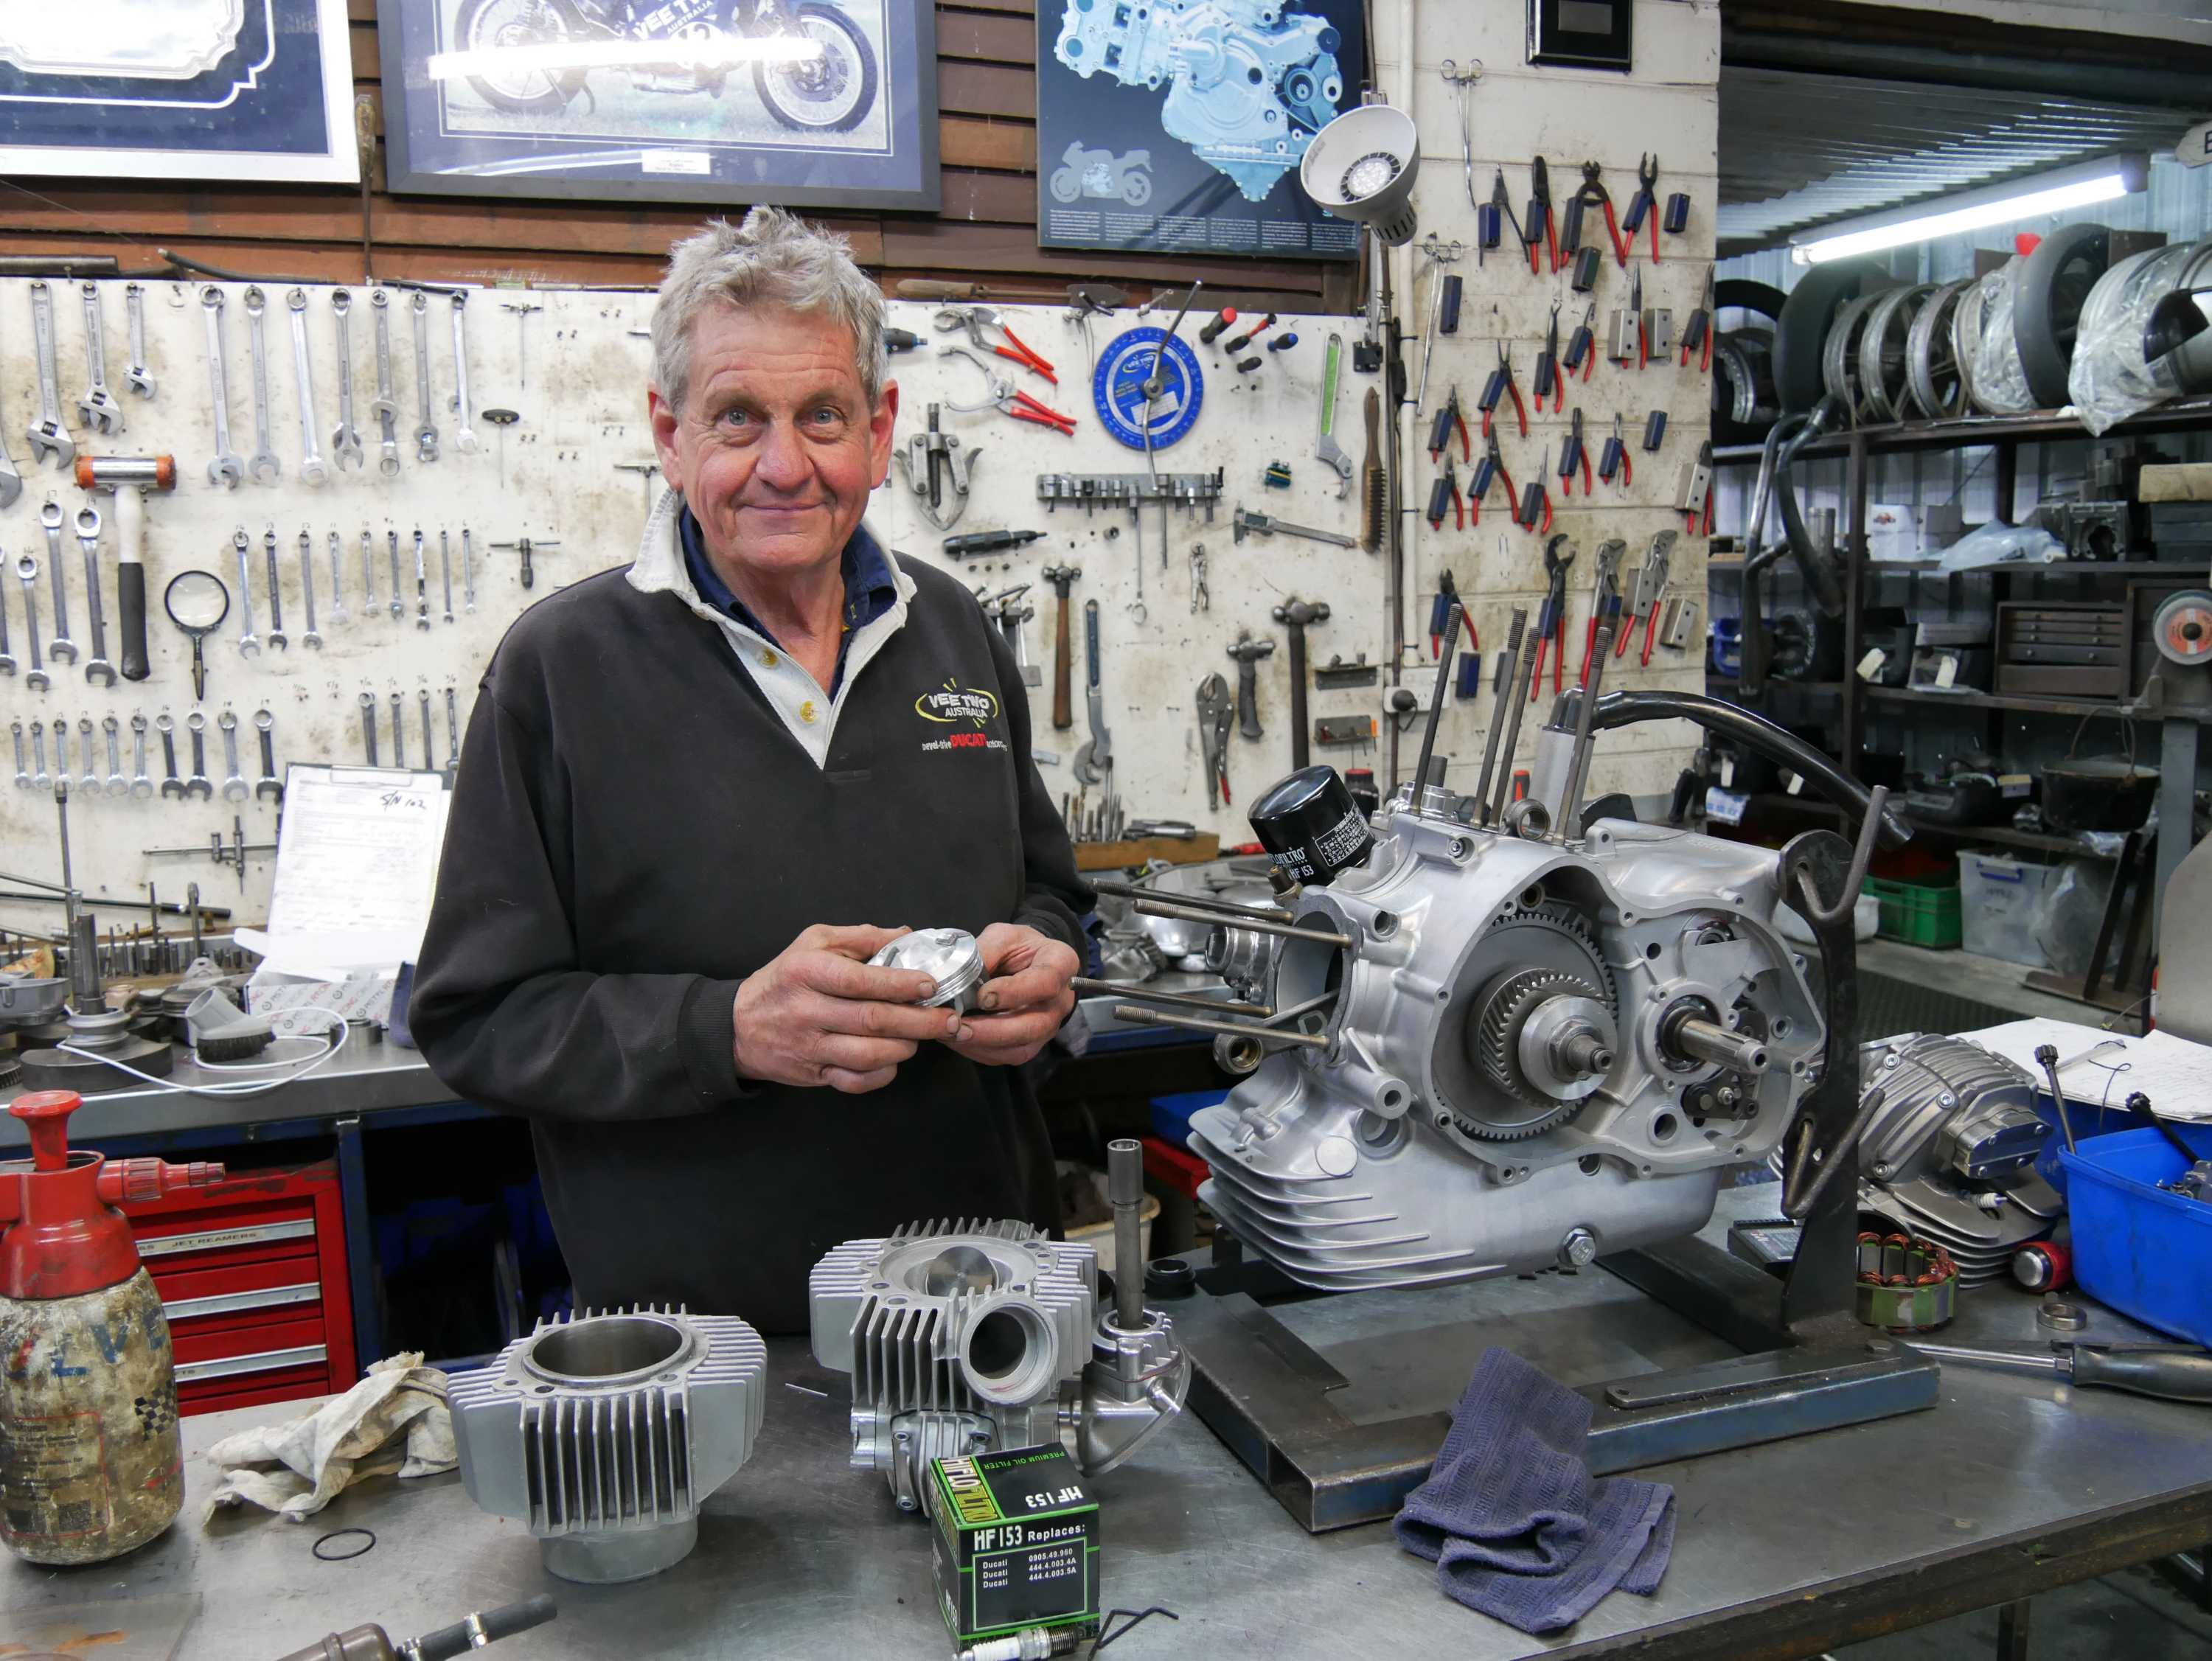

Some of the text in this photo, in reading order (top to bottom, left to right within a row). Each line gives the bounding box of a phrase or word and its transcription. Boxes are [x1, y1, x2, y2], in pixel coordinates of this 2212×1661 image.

[928, 693, 990, 709] VEE TWO
[945, 707, 988, 717] AUSTRALIA
[1267, 848, 1305, 864] FLOFILTRO
[198, 1233, 257, 1244] REAMERS
[984, 1460, 1012, 1470] FILTER
[1029, 1451, 1065, 1463] PREMIUM
[939, 1458, 999, 1522] HIFLOFILTRO
[1027, 1524, 1086, 1542] Replaces:
[982, 1547, 1073, 1570] Ducati 0905.49.960
[982, 1557, 1077, 1579] Ducati 444.4.003.4A
[982, 1567, 1077, 1589] Ducati 444.4.003.5A
